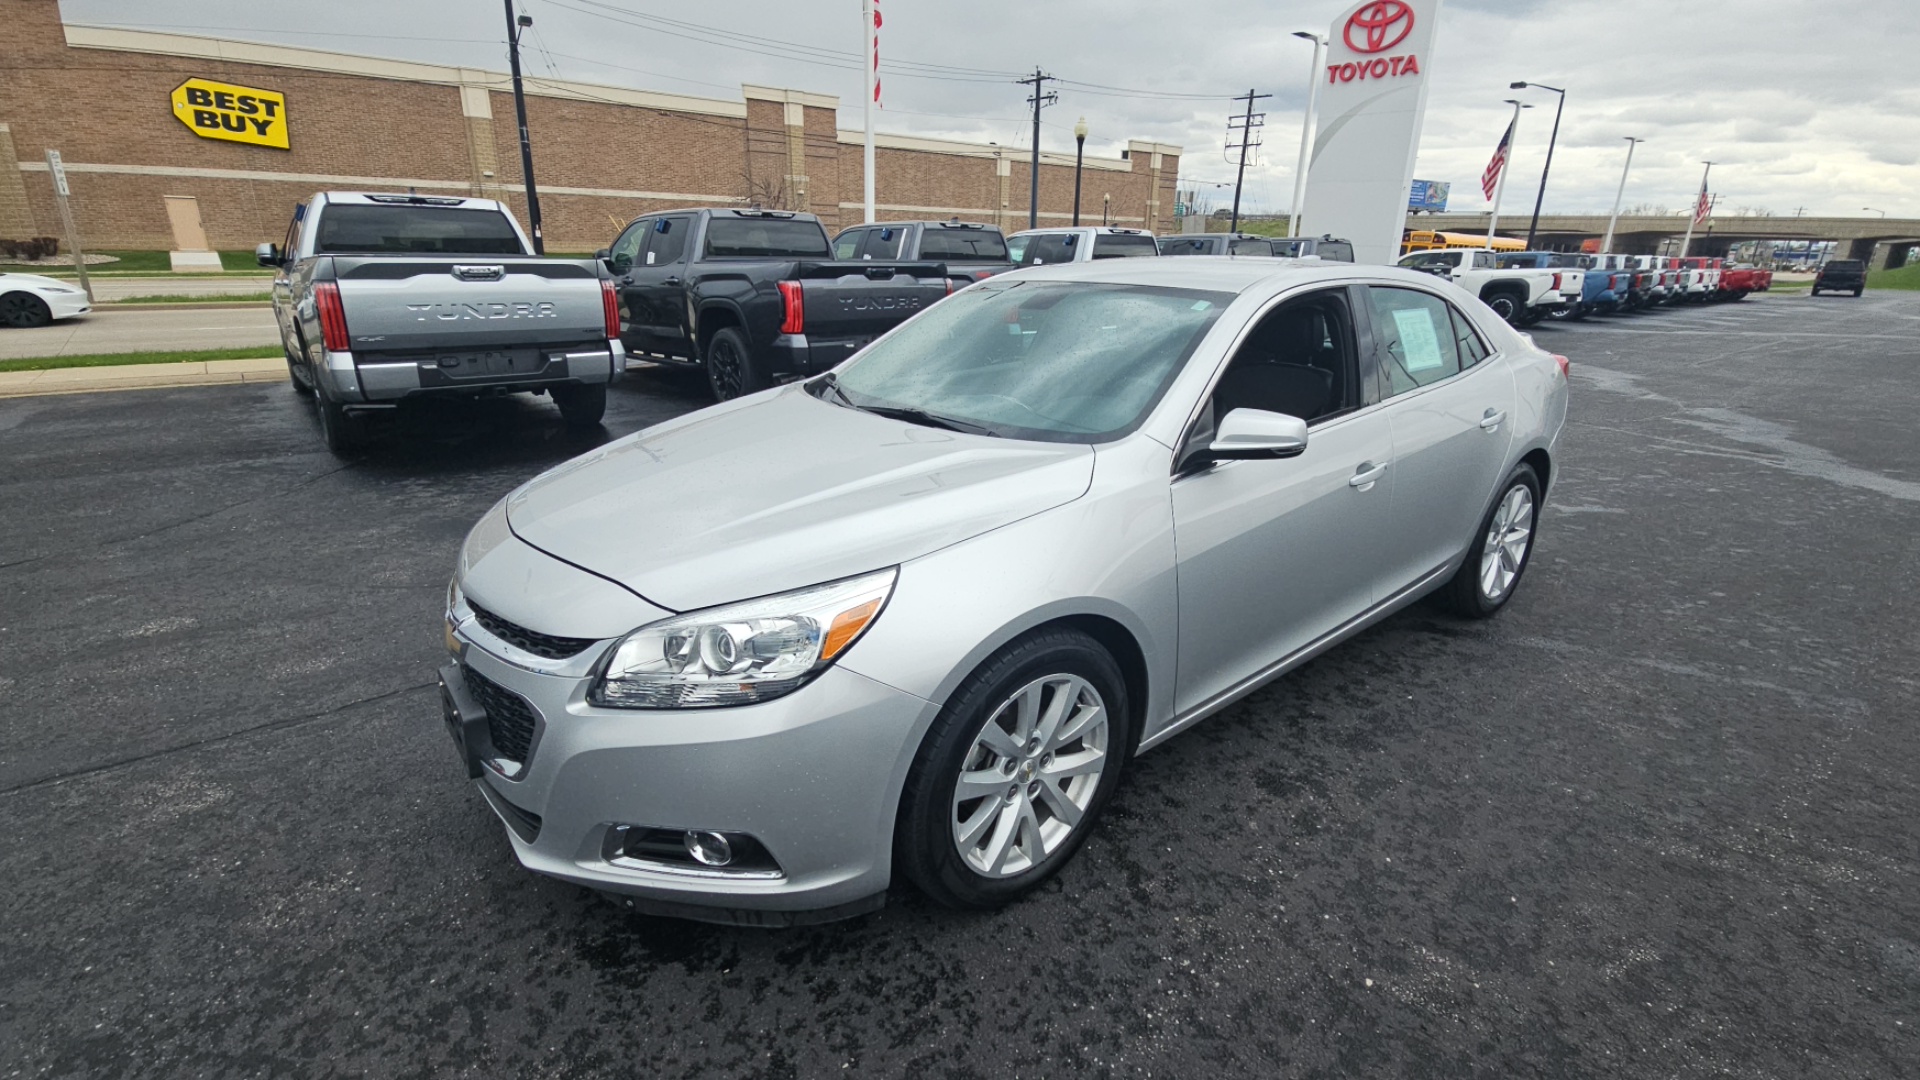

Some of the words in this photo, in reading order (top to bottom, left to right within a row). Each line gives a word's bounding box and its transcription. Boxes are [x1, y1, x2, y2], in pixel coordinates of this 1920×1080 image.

[1327, 55, 1419, 84] TOYOTA
[186, 87, 279, 117] BEST
[193, 109, 274, 136] BUY
[406, 301, 557, 321] TUNDRA
[839, 297, 920, 311] TUNDRA
